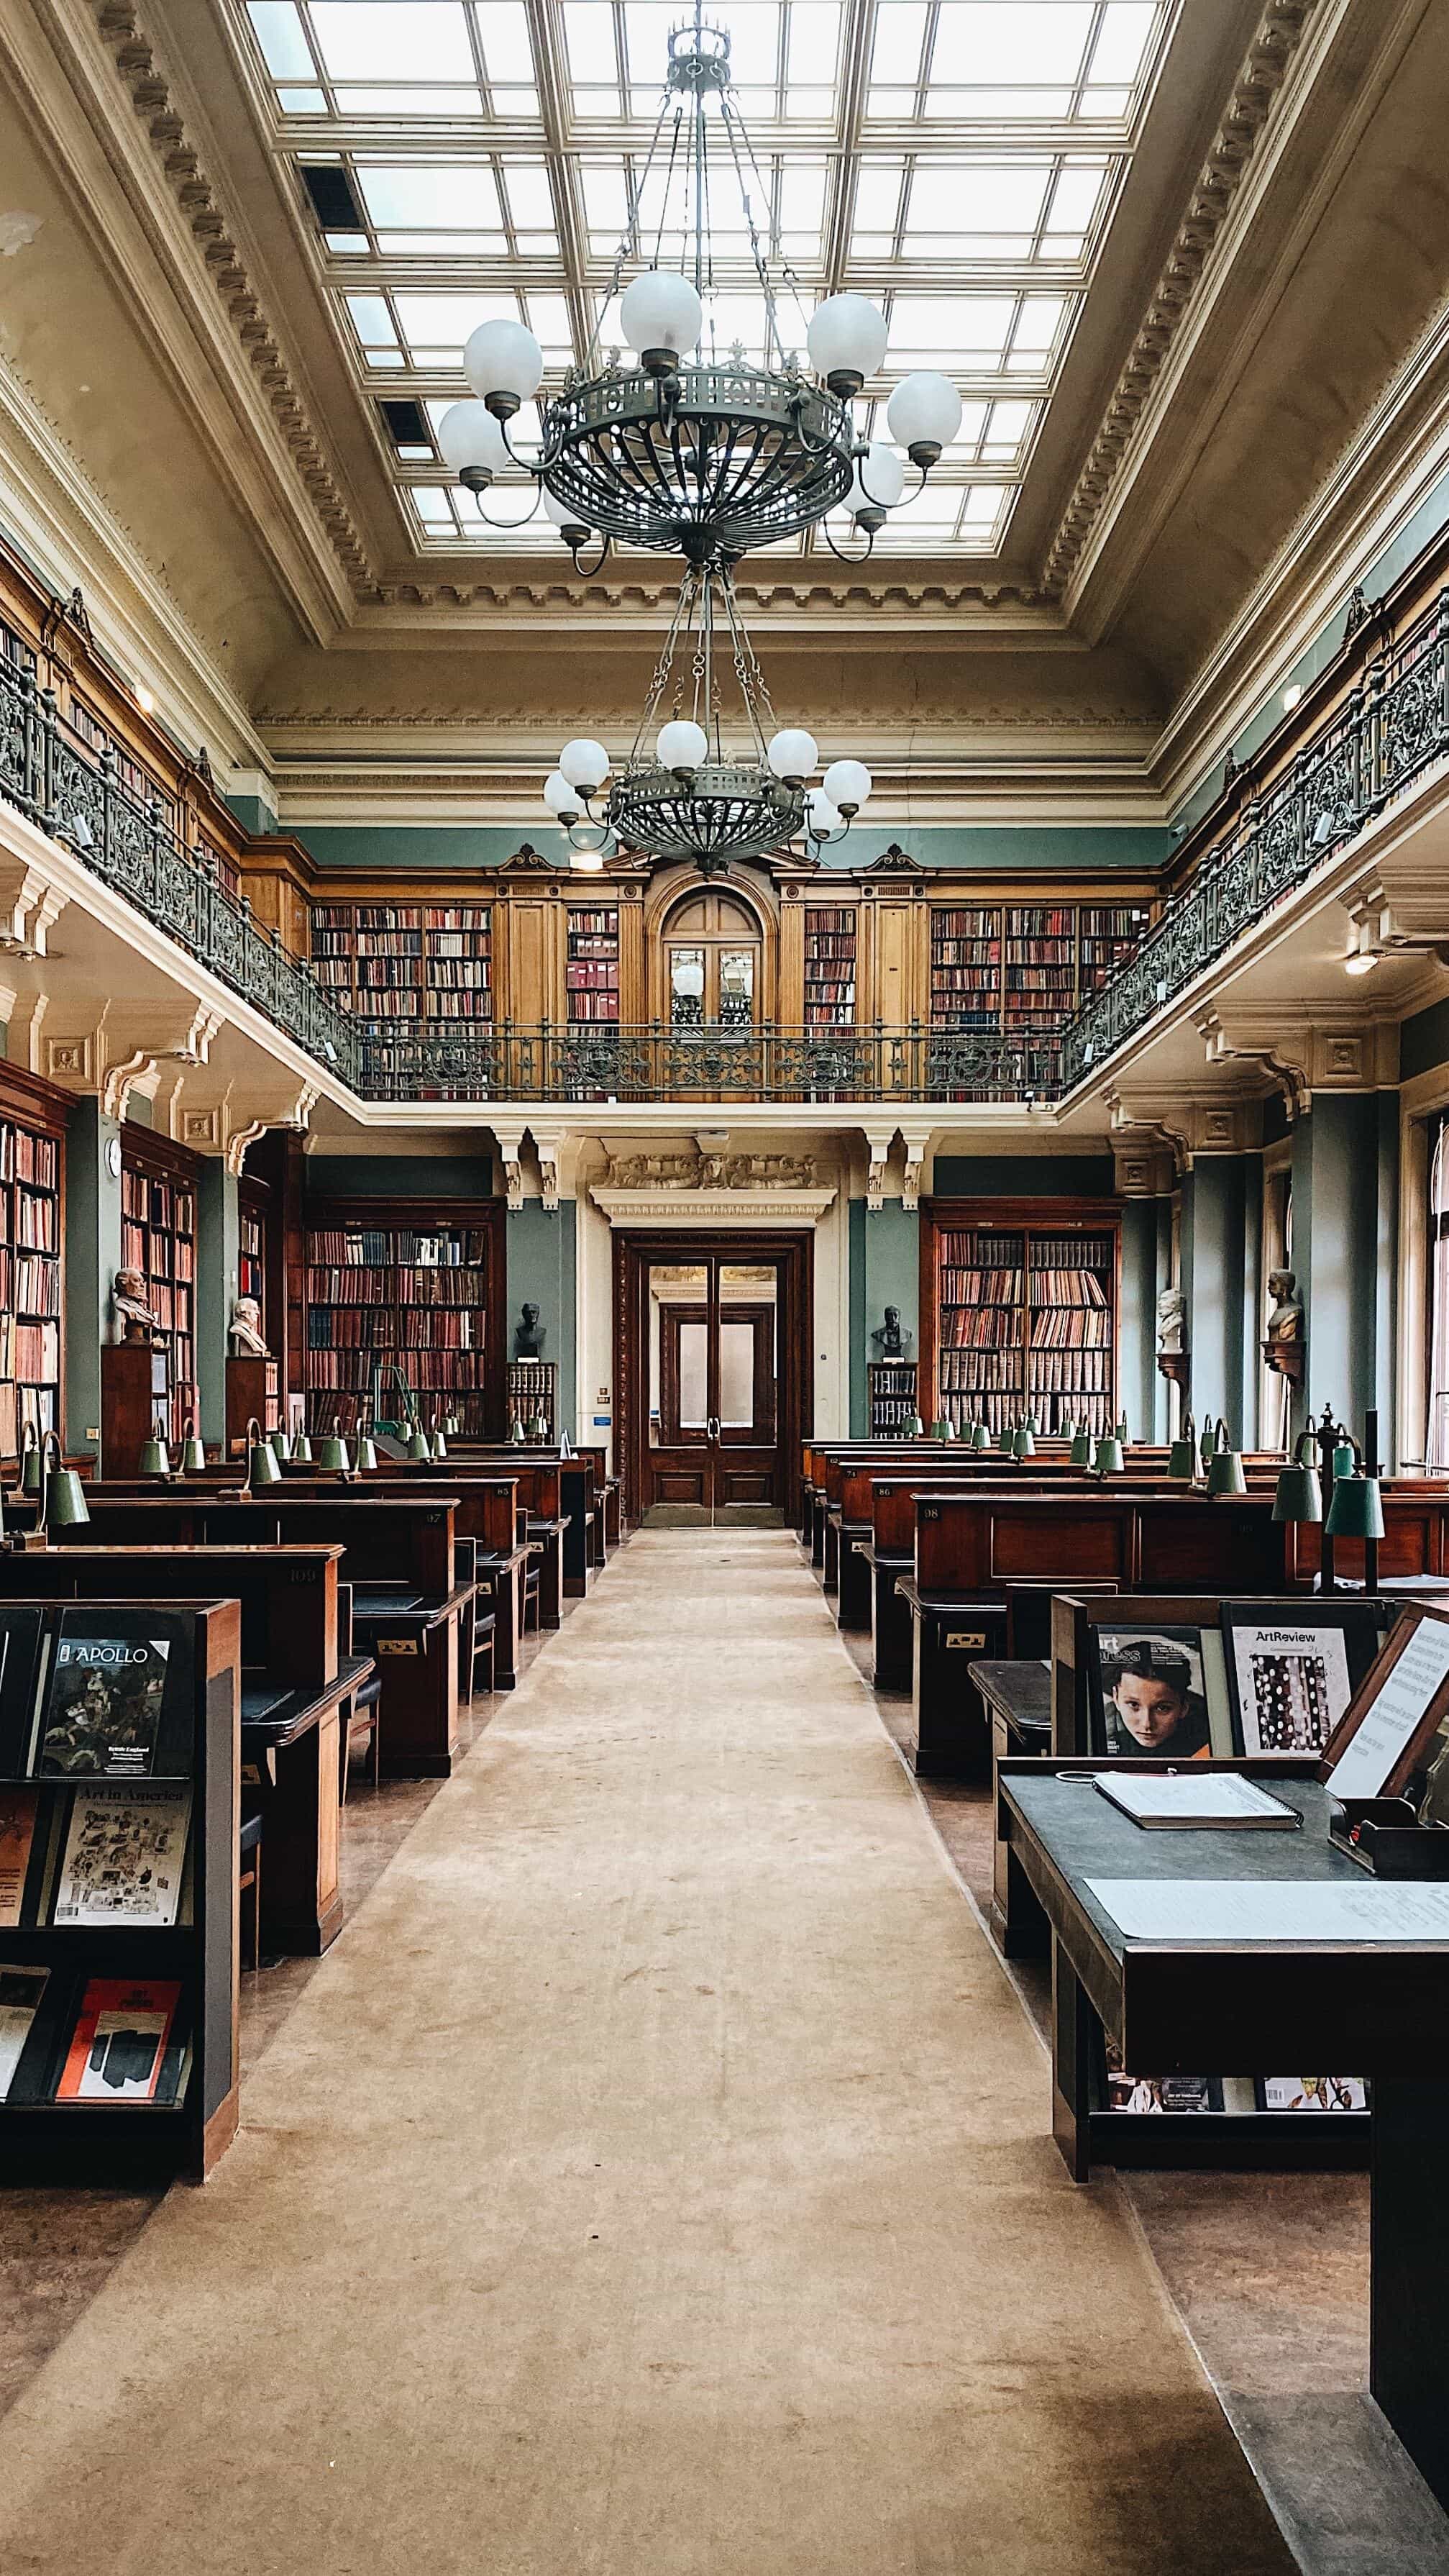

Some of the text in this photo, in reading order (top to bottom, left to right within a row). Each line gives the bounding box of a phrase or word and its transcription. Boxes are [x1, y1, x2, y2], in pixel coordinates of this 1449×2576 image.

[426, 1514, 442, 1523] 97
[924, 1508, 938, 1519] 98
[291, 1569, 316, 1582] 109
[1256, 1631, 1315, 1642] ArtReview
[76, 1647, 148, 1663] APOLLO
[79, 1788, 184, 1801] Art in America
